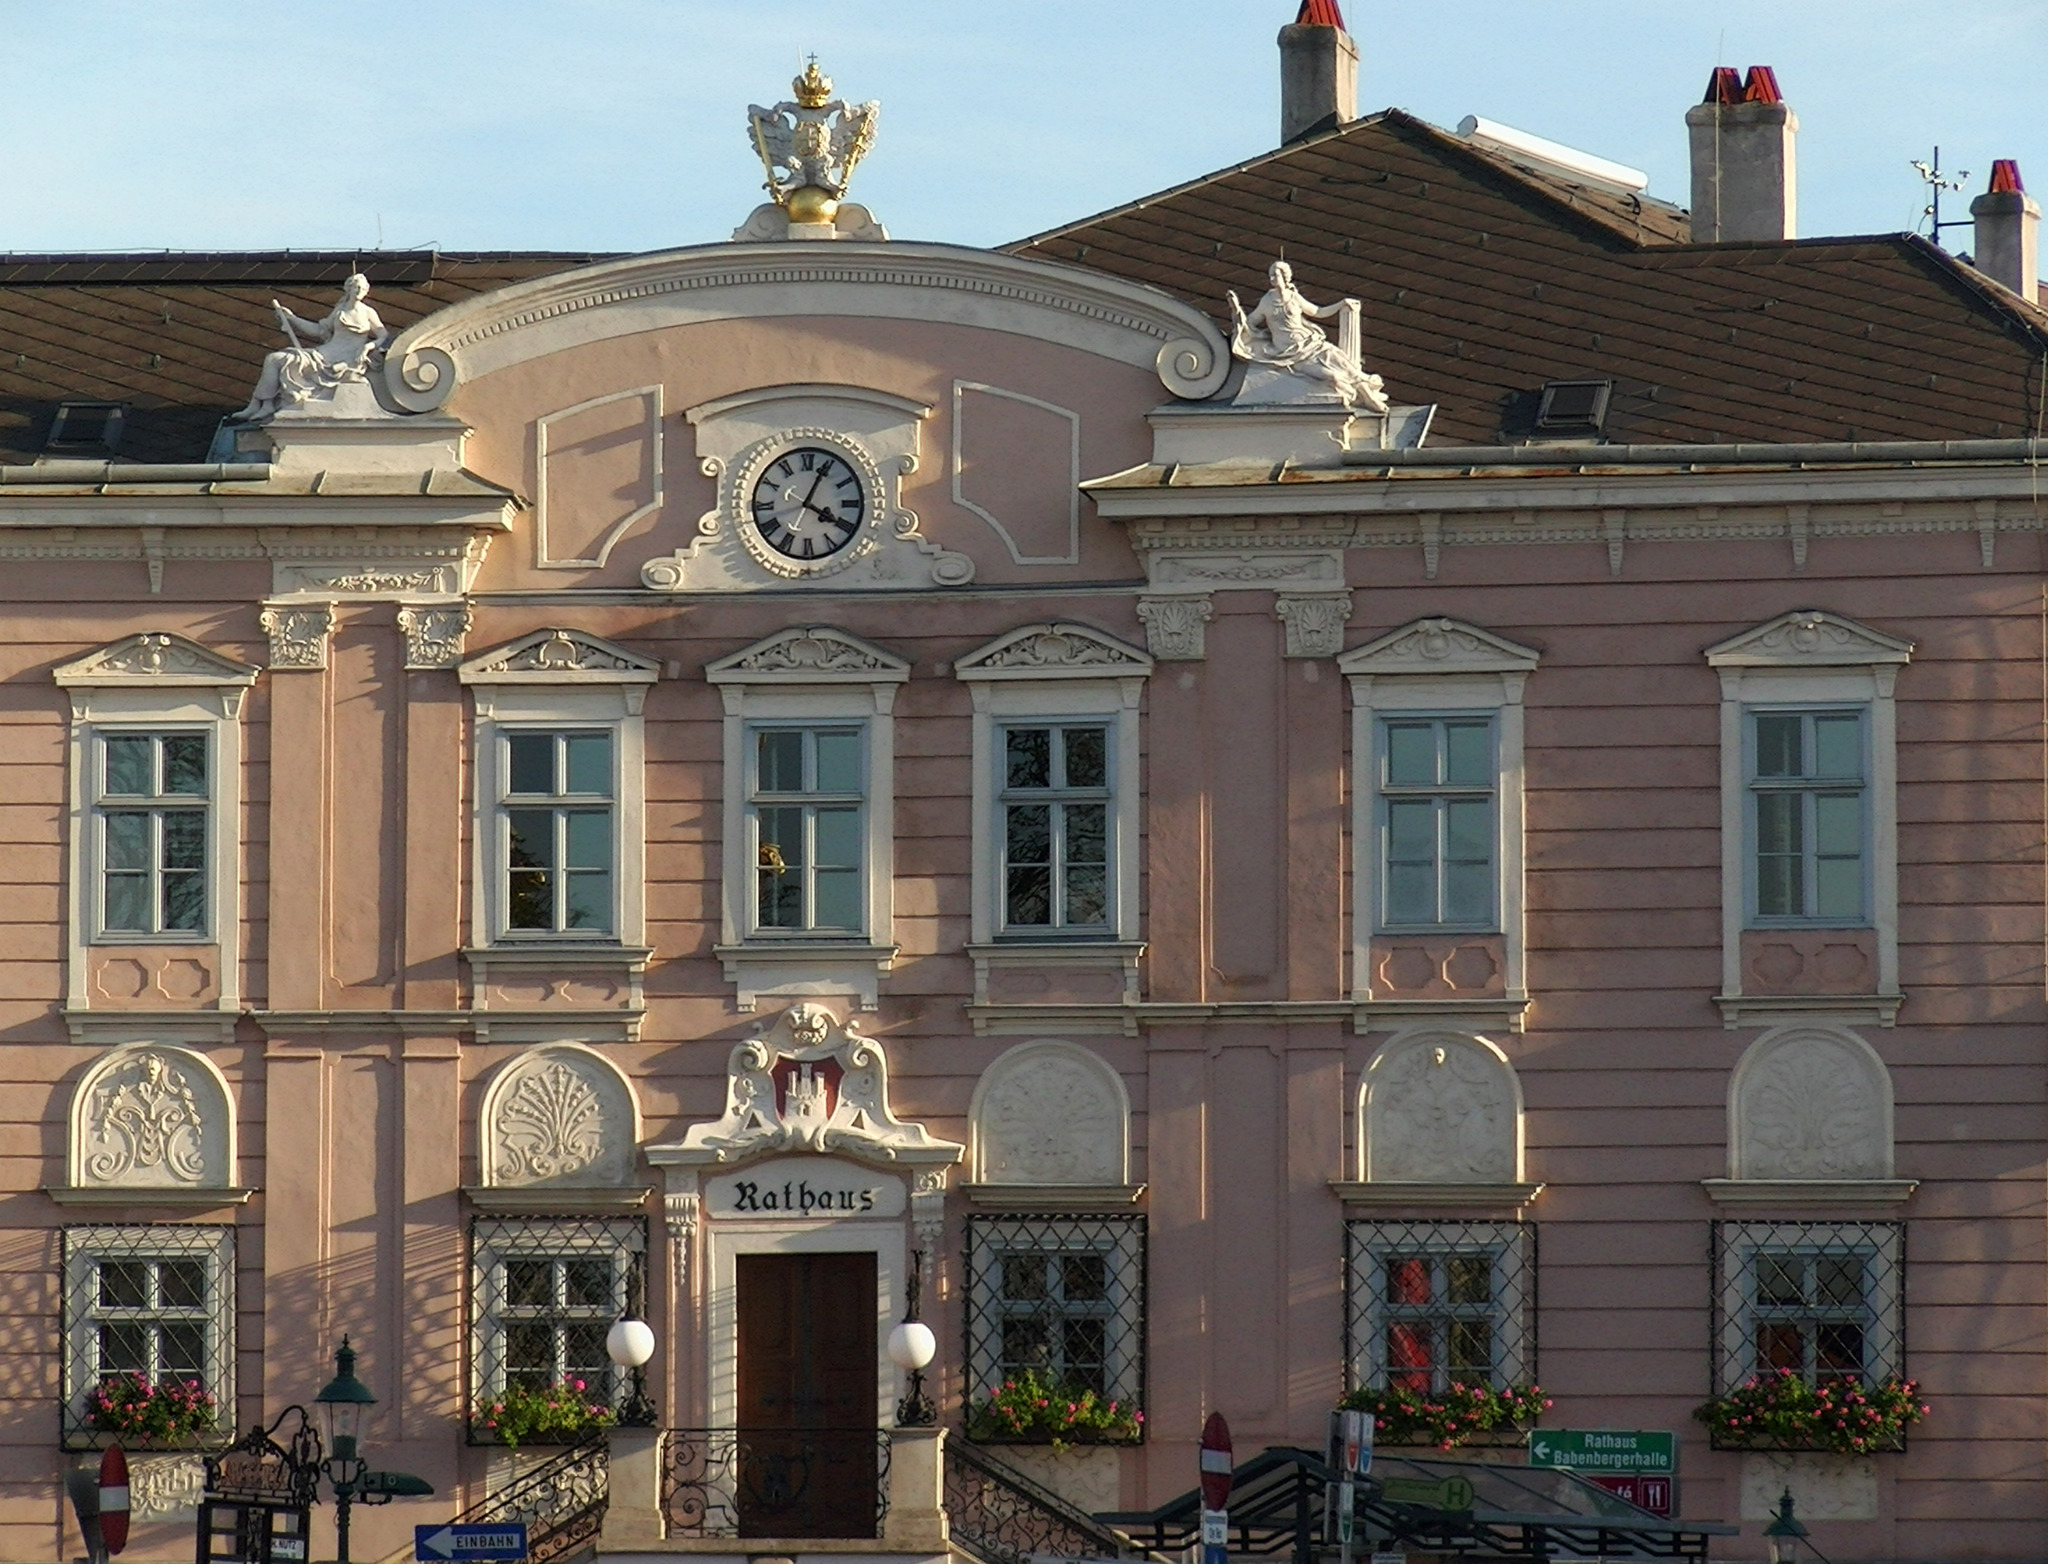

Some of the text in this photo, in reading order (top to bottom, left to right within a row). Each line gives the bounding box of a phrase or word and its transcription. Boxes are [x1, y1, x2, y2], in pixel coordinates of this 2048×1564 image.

[734, 1180, 875, 1215] Rathaus
[1585, 1434, 1637, 1449] Rathaus
[1554, 1451, 1668, 1467] Babenbergerhalle
[1447, 1482, 1465, 1506] H
[456, 1535, 514, 1548] EINBAHN
